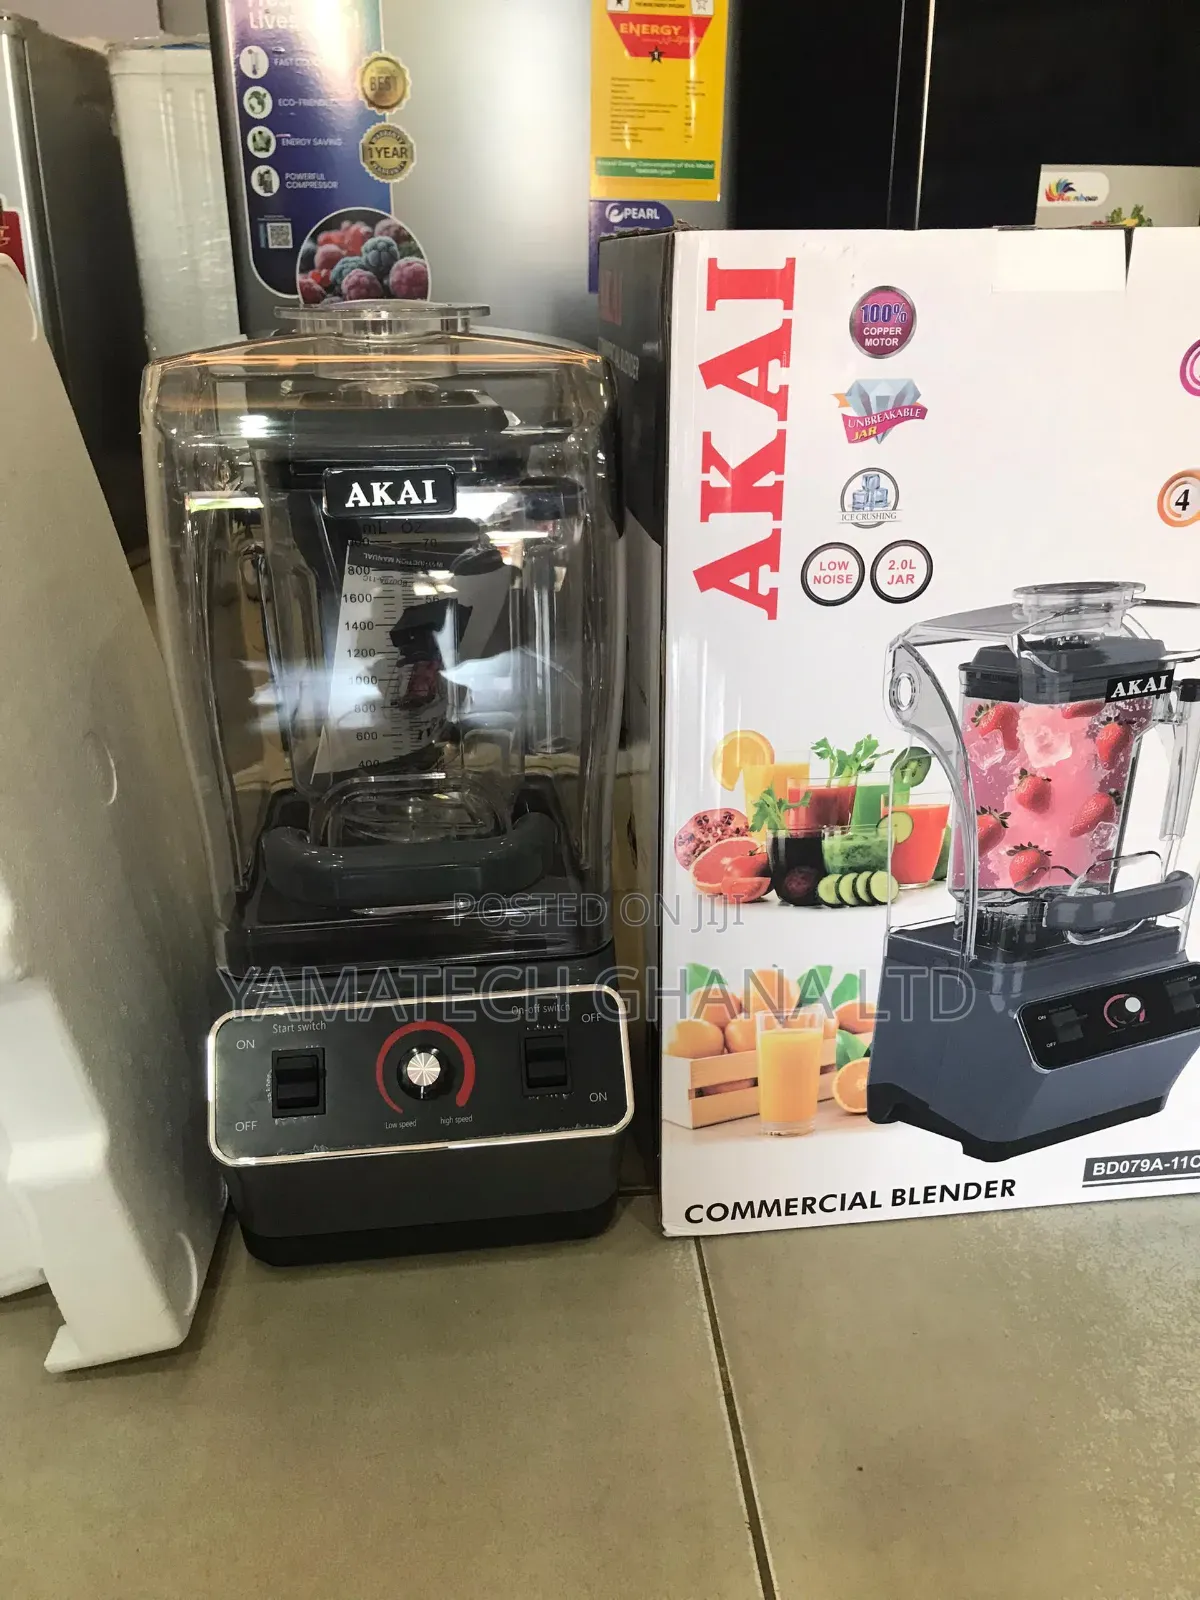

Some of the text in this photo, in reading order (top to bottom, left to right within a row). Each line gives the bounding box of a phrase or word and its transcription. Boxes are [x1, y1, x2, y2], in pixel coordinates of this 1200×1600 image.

[620, 22, 682, 36] ENERGY
[369, 75, 399, 92] BEST
[278, 98, 340, 107] ECO-FRIEND
[281, 138, 343, 147] ENERGY SAVING
[375, 147, 409, 159] YEAR
[284, 172, 325, 181] POWERFUL
[285, 181, 339, 190] COMPRESSOR
[622, 207, 660, 220] PEARL
[860, 302, 908, 324] 100%
[863, 326, 902, 336] COPPER
[864, 337, 899, 347] MOTOR
[848, 406, 921, 428] UNBREAKABLE
[852, 425, 878, 441] JAR
[693, 257, 796, 621] AKAI
[345, 479, 437, 508] AKAI
[1174, 488, 1190, 511] 4
[841, 511, 897, 521] ICE CRUSHING
[422, 538, 437, 549] 70
[363, 552, 395, 564] MANUAL
[819, 560, 849, 571] LOW
[888, 558, 916, 570] 2.0L
[341, 565, 371, 575] 800
[813, 574, 853, 585] NOISE
[887, 573, 915, 585] JAR
[342, 593, 372, 603] 1600
[345, 621, 374, 631] 1400
[347, 648, 376, 658] 1200
[1110, 674, 1169, 699] AKAI
[354, 703, 377, 713] 800
[356, 731, 378, 741] 600
[358, 759, 380, 769] 400
[511, 1001, 570, 1016] On-off switch
[581, 1013, 602, 1023] OFF
[272, 1020, 327, 1034] Start switch
[236, 1039, 255, 1050] ON
[589, 1091, 608, 1102] ON
[385, 1119, 417, 1130] Low speed
[440, 1114, 473, 1126] high speed
[235, 1120, 257, 1132] OFF
[1092, 1154, 1200, 1176] BD079A-11C
[684, 1178, 1017, 1224] COMMERCIAL BLENDER
